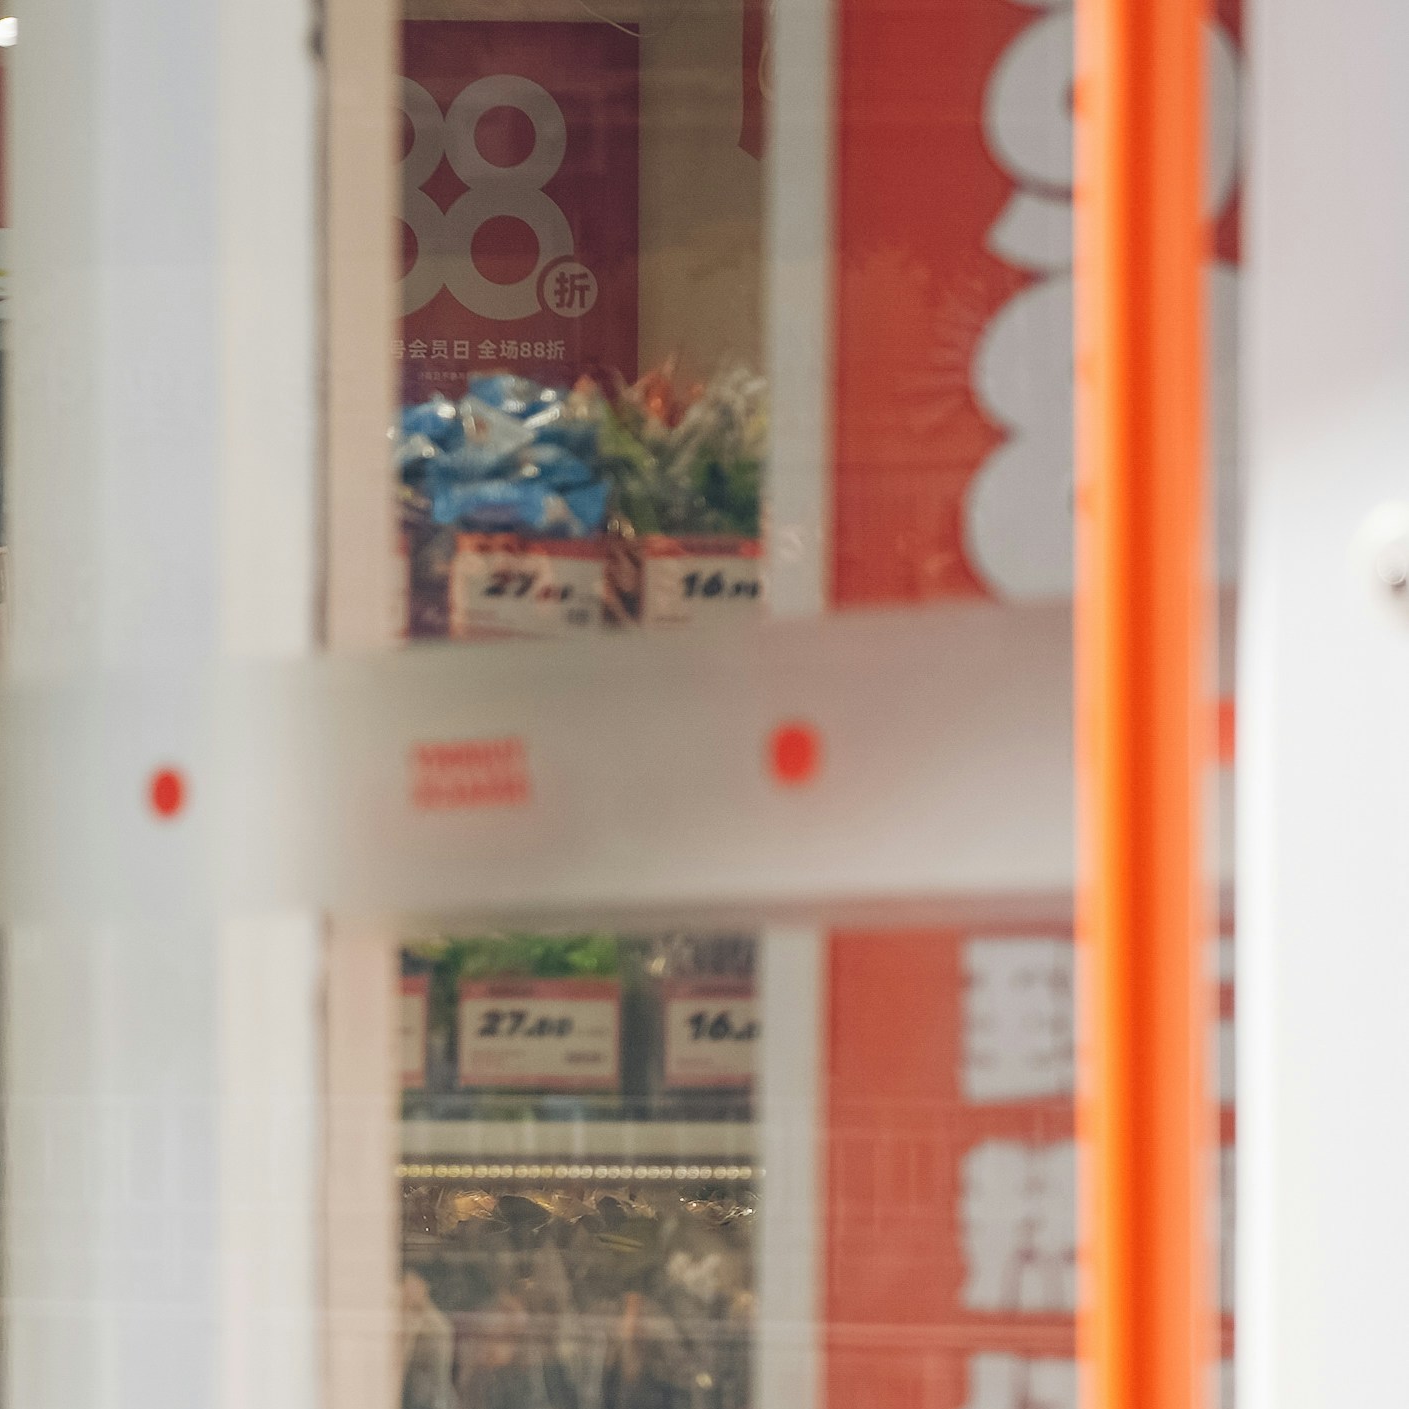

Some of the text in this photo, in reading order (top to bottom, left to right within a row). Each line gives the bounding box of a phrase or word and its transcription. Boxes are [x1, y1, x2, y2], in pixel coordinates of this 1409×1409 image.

[555, 271, 590, 309] 折
[478, 339, 565, 359] 全场88折
